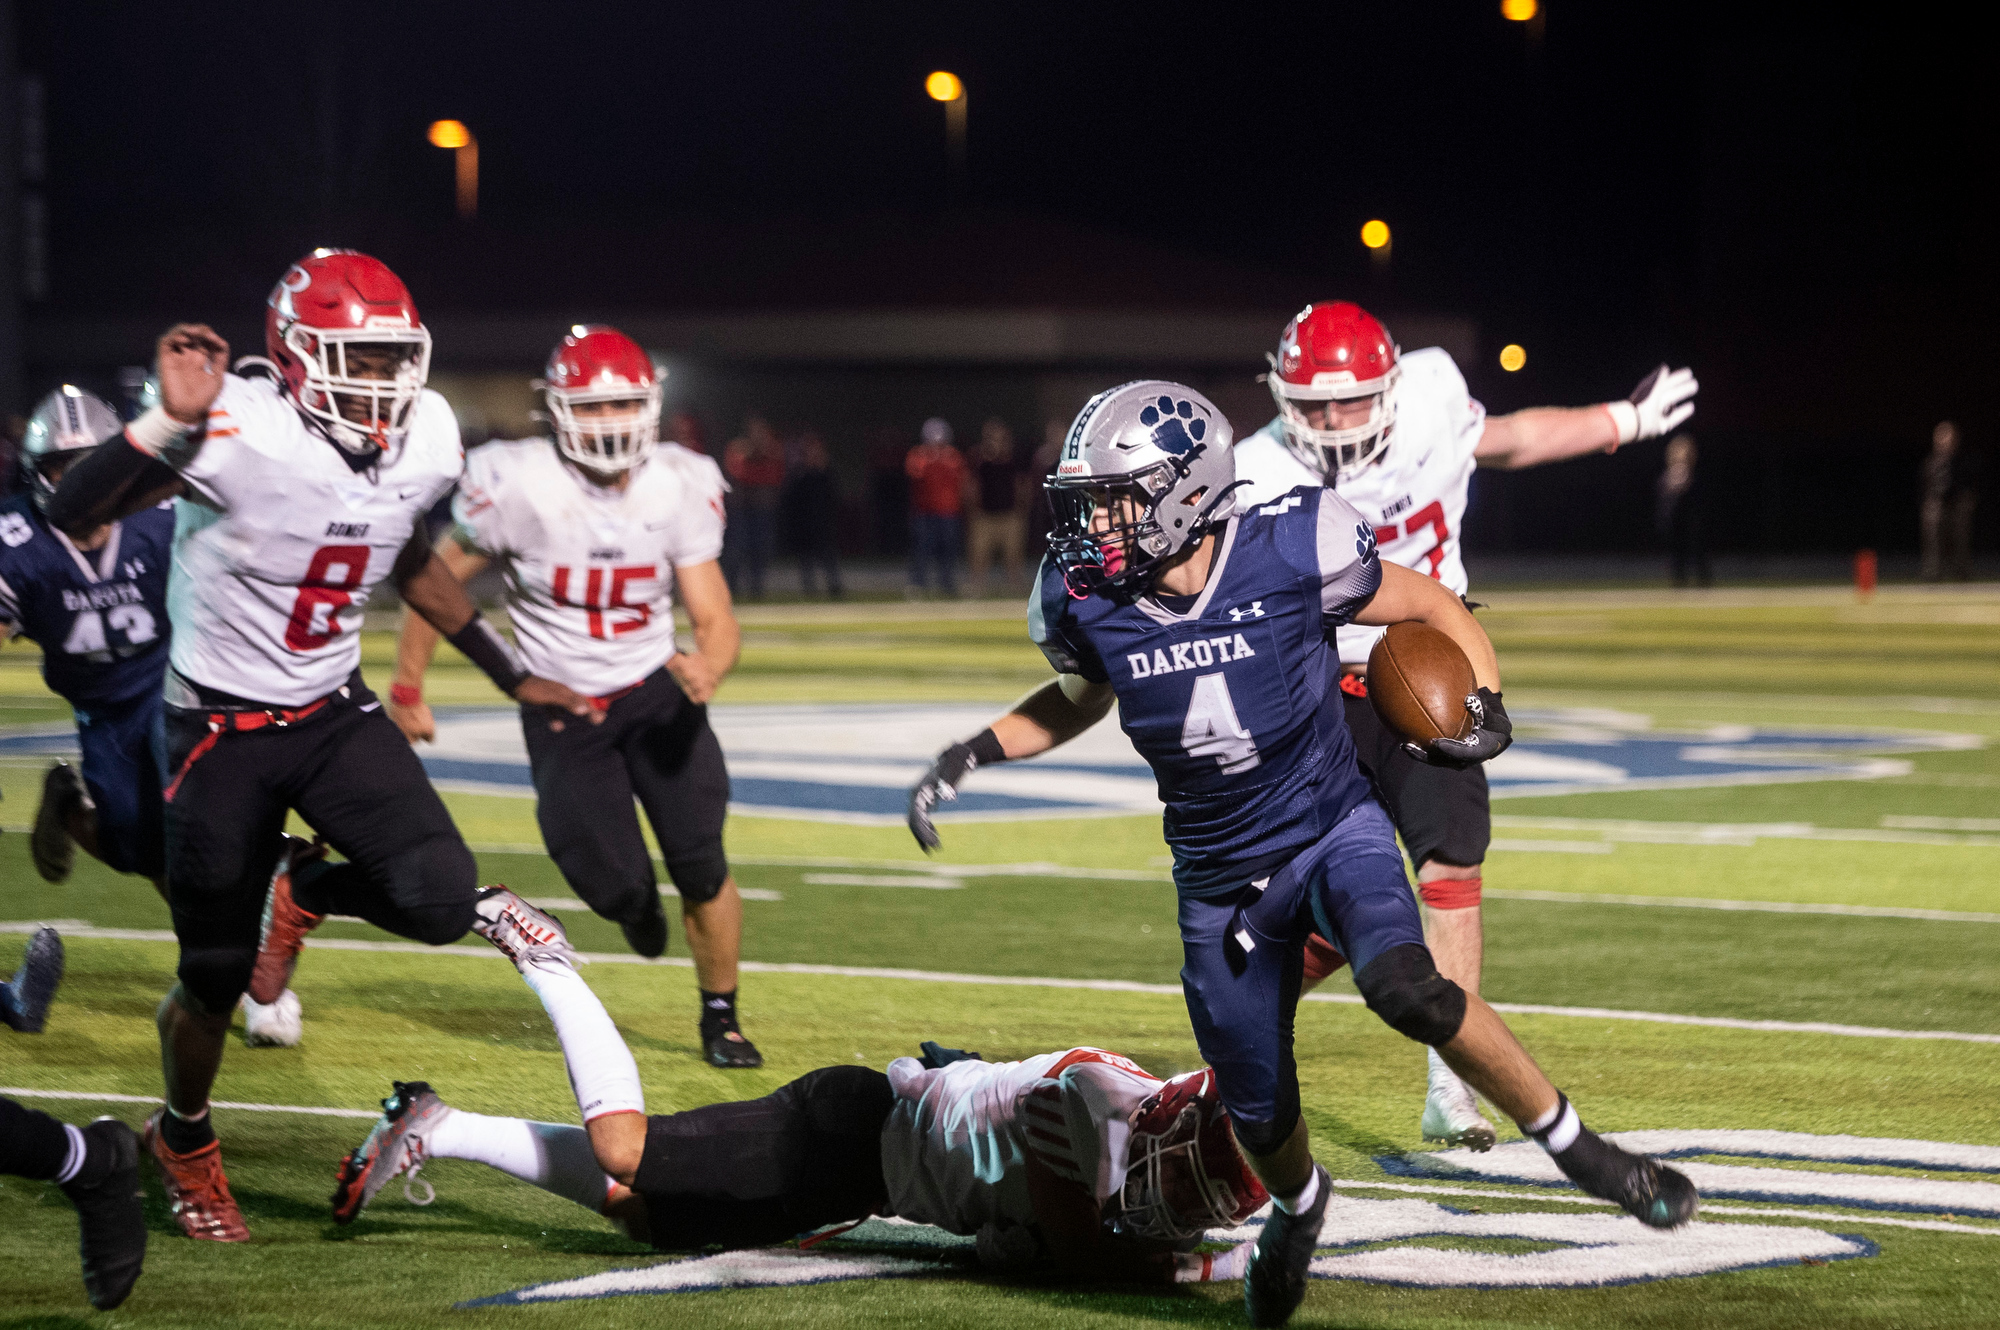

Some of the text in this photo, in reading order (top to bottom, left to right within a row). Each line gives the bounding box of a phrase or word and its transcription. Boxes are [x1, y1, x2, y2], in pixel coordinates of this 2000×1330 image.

[62, 602, 159, 664] 43
[285, 545, 371, 652] 8
[552, 564, 657, 639] 45
[1127, 632, 1256, 680] DAKOTA
[1180, 671, 1262, 776] 4
